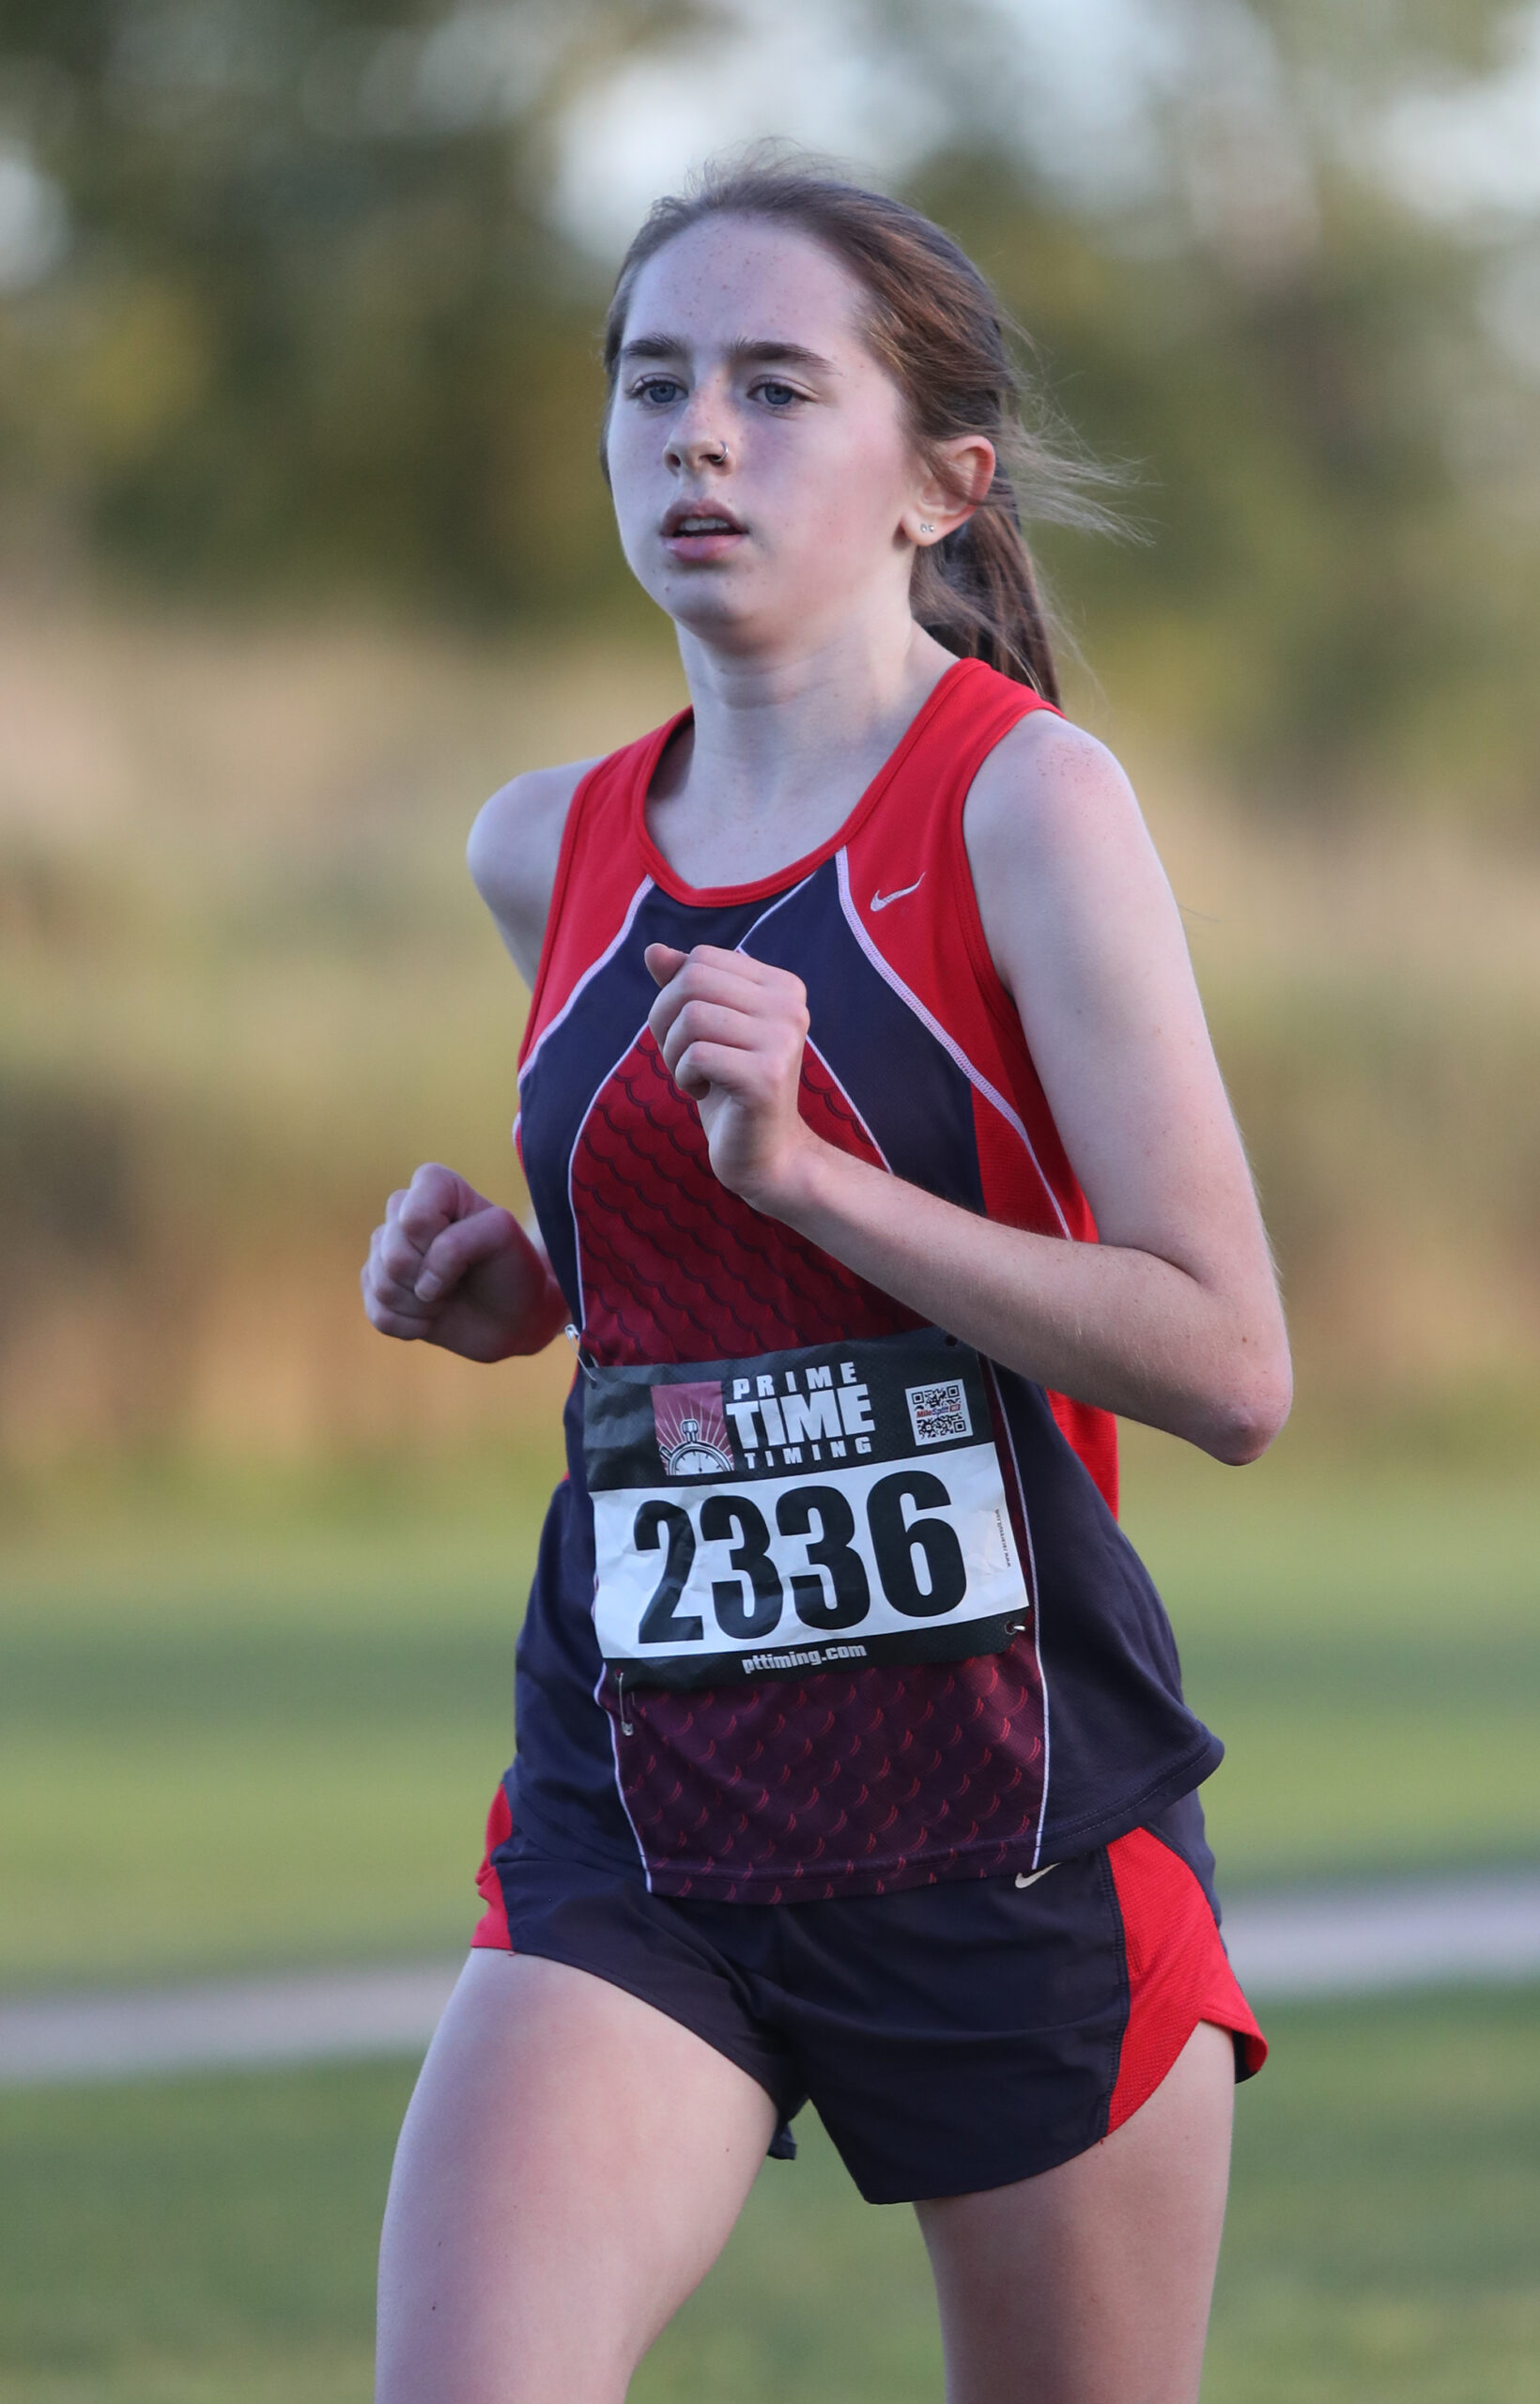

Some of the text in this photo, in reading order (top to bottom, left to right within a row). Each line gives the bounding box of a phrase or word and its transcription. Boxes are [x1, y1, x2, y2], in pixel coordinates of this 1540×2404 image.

[732, 1362, 856, 1400] PRIME
[726, 1383, 876, 1449] TIME
[745, 1437, 871, 1470] TIMING
[634, 1471, 967, 1644] 2336
[741, 1645, 868, 1674] pttiming.com
